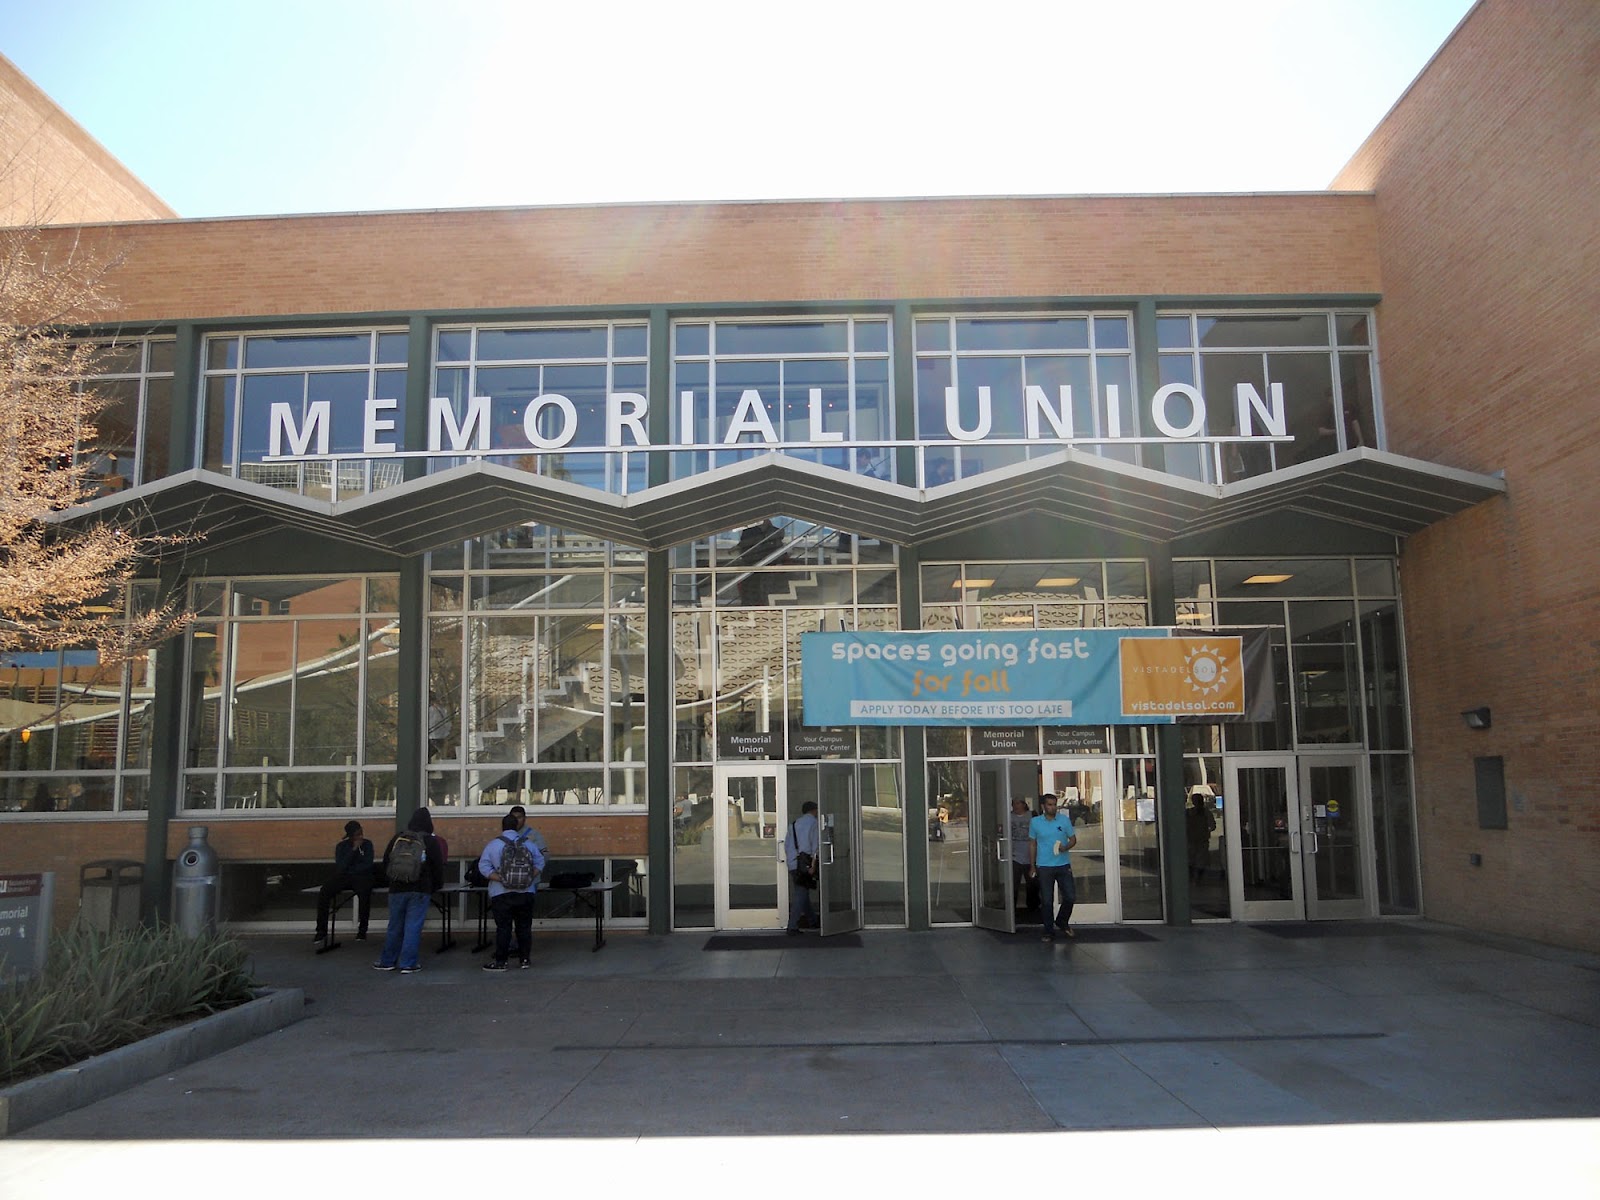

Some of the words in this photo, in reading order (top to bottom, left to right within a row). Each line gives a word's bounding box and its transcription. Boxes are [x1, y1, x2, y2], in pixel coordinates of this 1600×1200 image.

[269, 388, 843, 456] MEMORIAL
[945, 382, 1286, 441] UNION
[831, 642, 931, 665] spaces
[940, 639, 1018, 667] going
[1027, 637, 1090, 664] fast
[912, 669, 953, 697] for
[961, 669, 1012, 697] fall
[860, 704, 895, 715] APPLY
[898, 704, 938, 715] TODAY
[941, 704, 983, 715] BEFORE
[986, 704, 1006, 715] IT'S
[1008, 704, 1034, 715] TOO
[1038, 704, 1063, 714] LATE
[1131, 700, 1235, 711] vistadelsol.com
[983, 729, 1025, 738] Memorial
[730, 735, 772, 744] Memorial
[991, 740, 1017, 748] Union
[1047, 739, 1082, 747] Community
[1082, 738, 1103, 746] Center
[738, 745, 764, 754] Union
[794, 744, 829, 752] Community
[0, 905, 29, 920] morial
